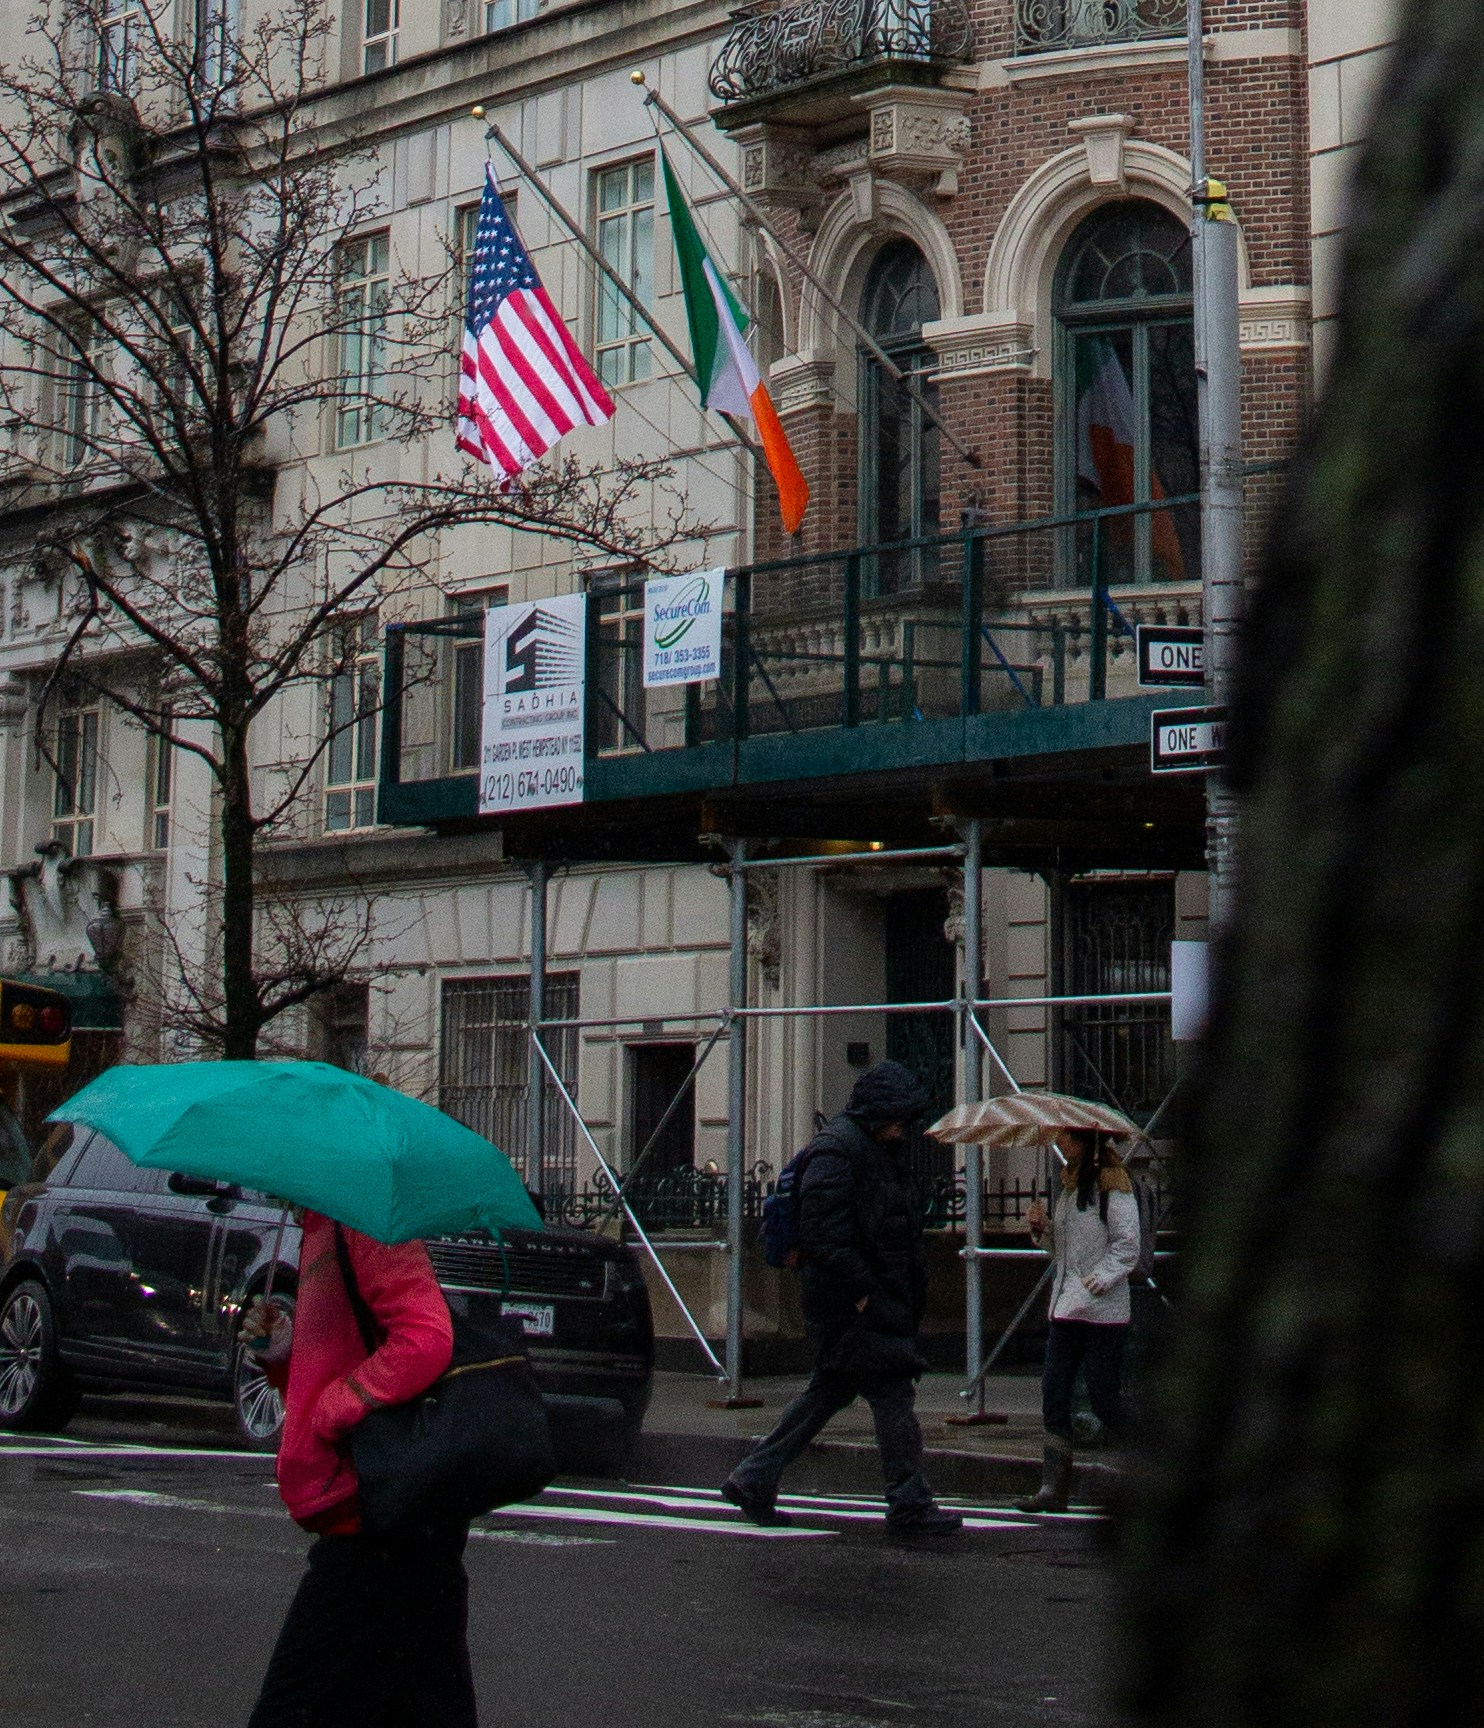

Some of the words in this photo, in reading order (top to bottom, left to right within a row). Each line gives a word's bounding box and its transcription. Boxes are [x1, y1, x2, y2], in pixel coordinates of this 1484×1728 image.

[654, 599, 711, 622] SecureCom
[675, 645, 711, 663] 353-3355
[1161, 645, 1203, 669] ONE
[1167, 727, 1198, 751] ONE
[484, 772, 514, 805] (212)
[518, 765, 576, 798] 671-0490
